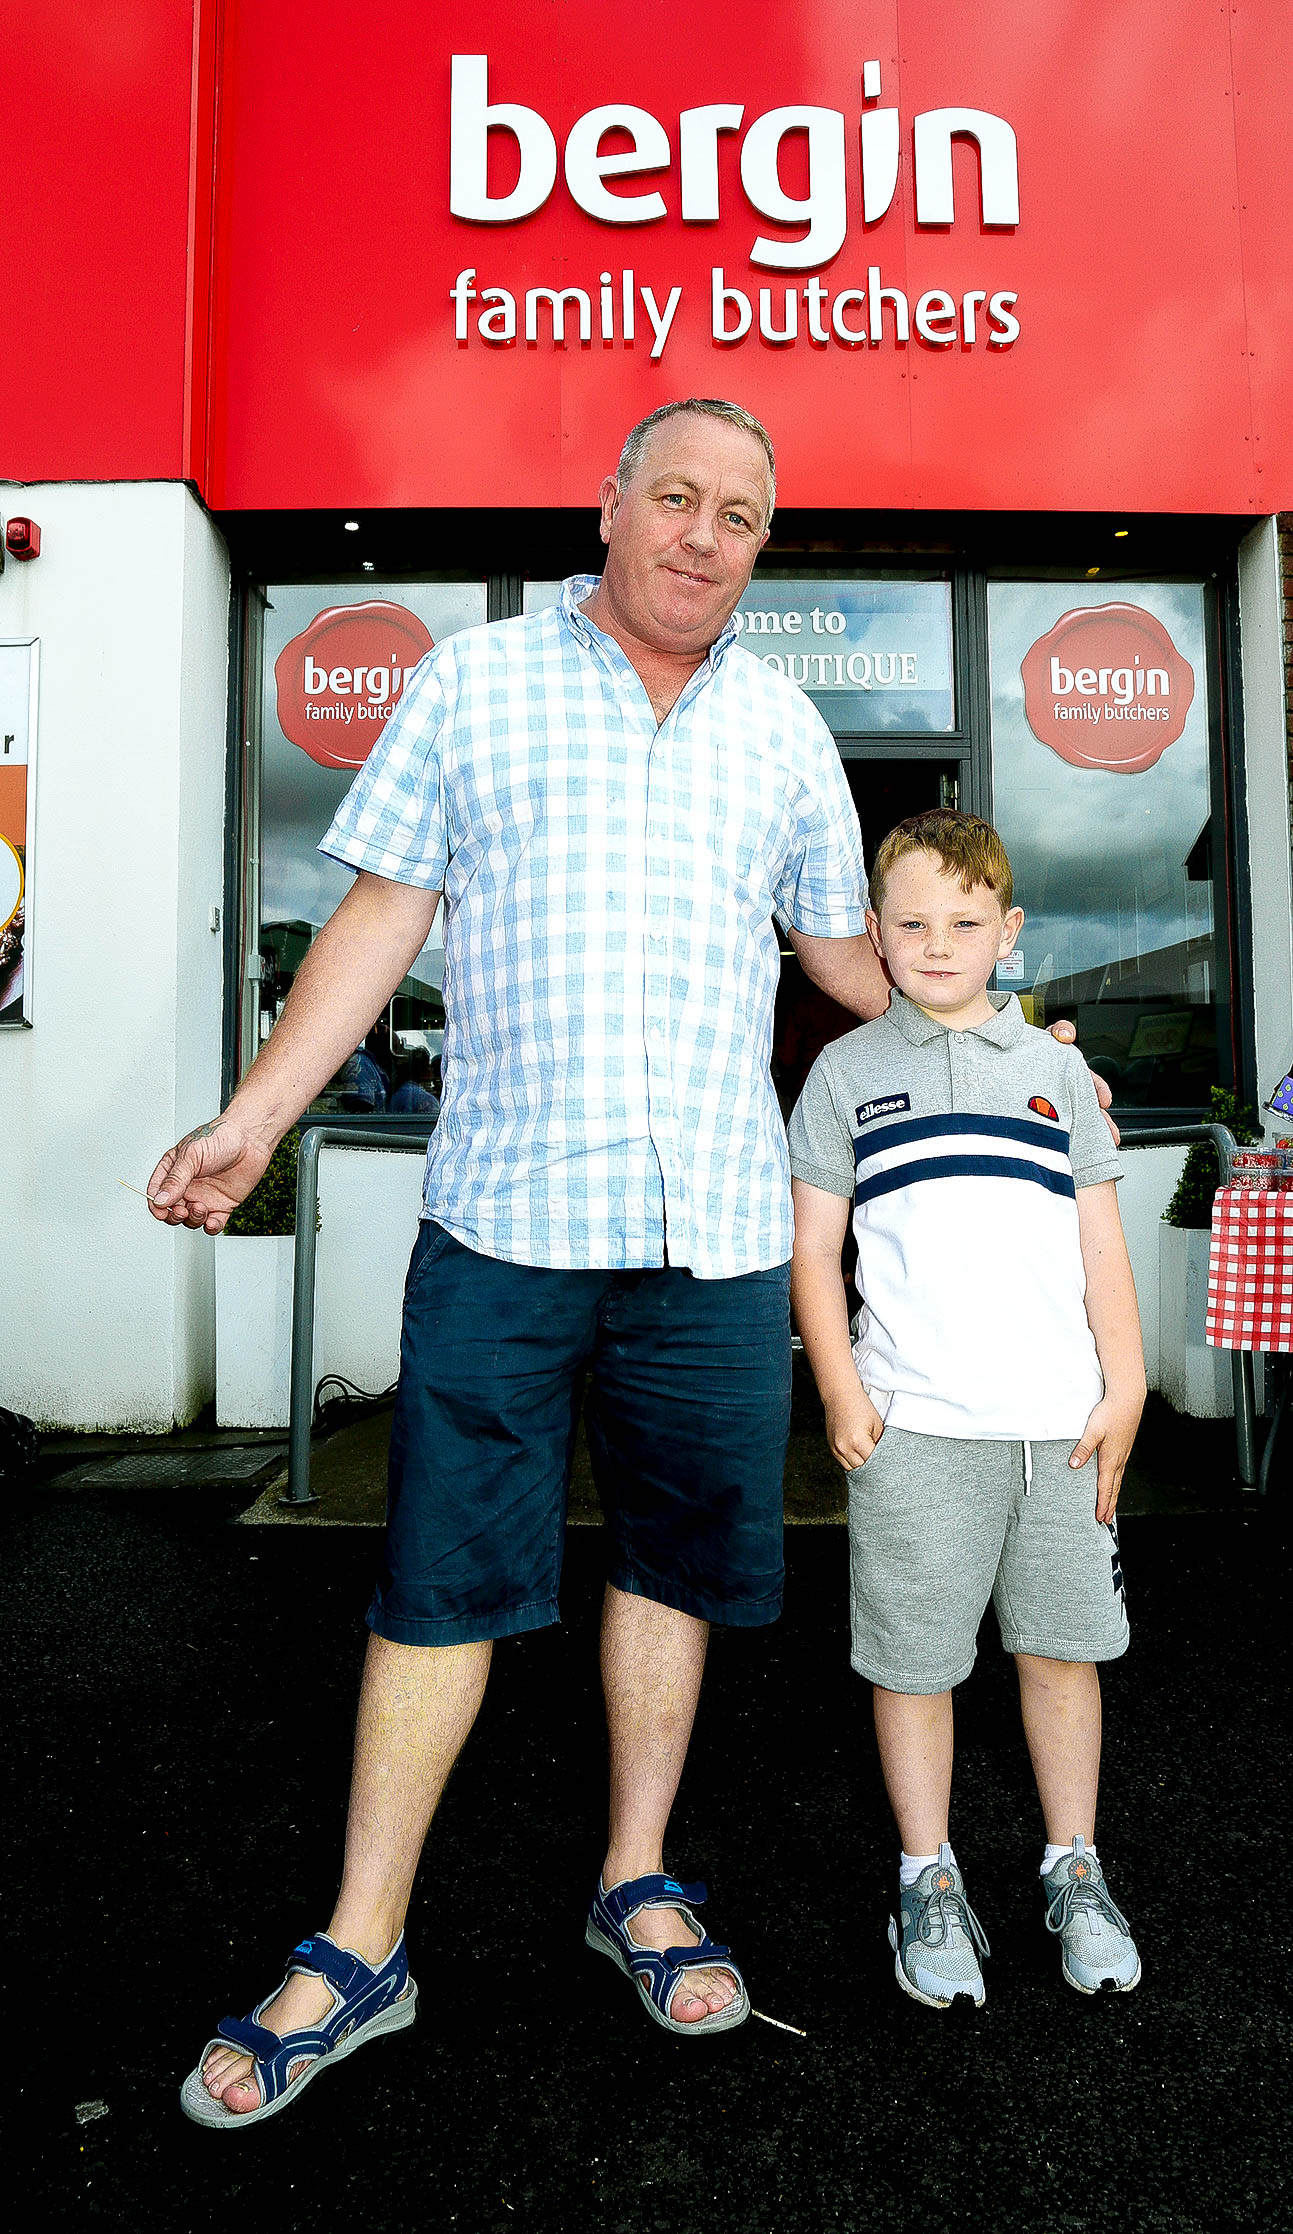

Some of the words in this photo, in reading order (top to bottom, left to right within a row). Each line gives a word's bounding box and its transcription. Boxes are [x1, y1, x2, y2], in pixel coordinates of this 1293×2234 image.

[450, 54, 1020, 269] bergin
[449, 268, 682, 359] family
[711, 266, 1020, 344] butchers
[809, 607, 847, 635] to
[761, 652, 919, 691] OUTIQUE
[1050, 654, 1170, 705] bergin
[304, 702, 355, 725] family
[1053, 702, 1101, 725] family
[1104, 702, 1170, 721] butchers
[860, 1099, 906, 1121] ellesse
